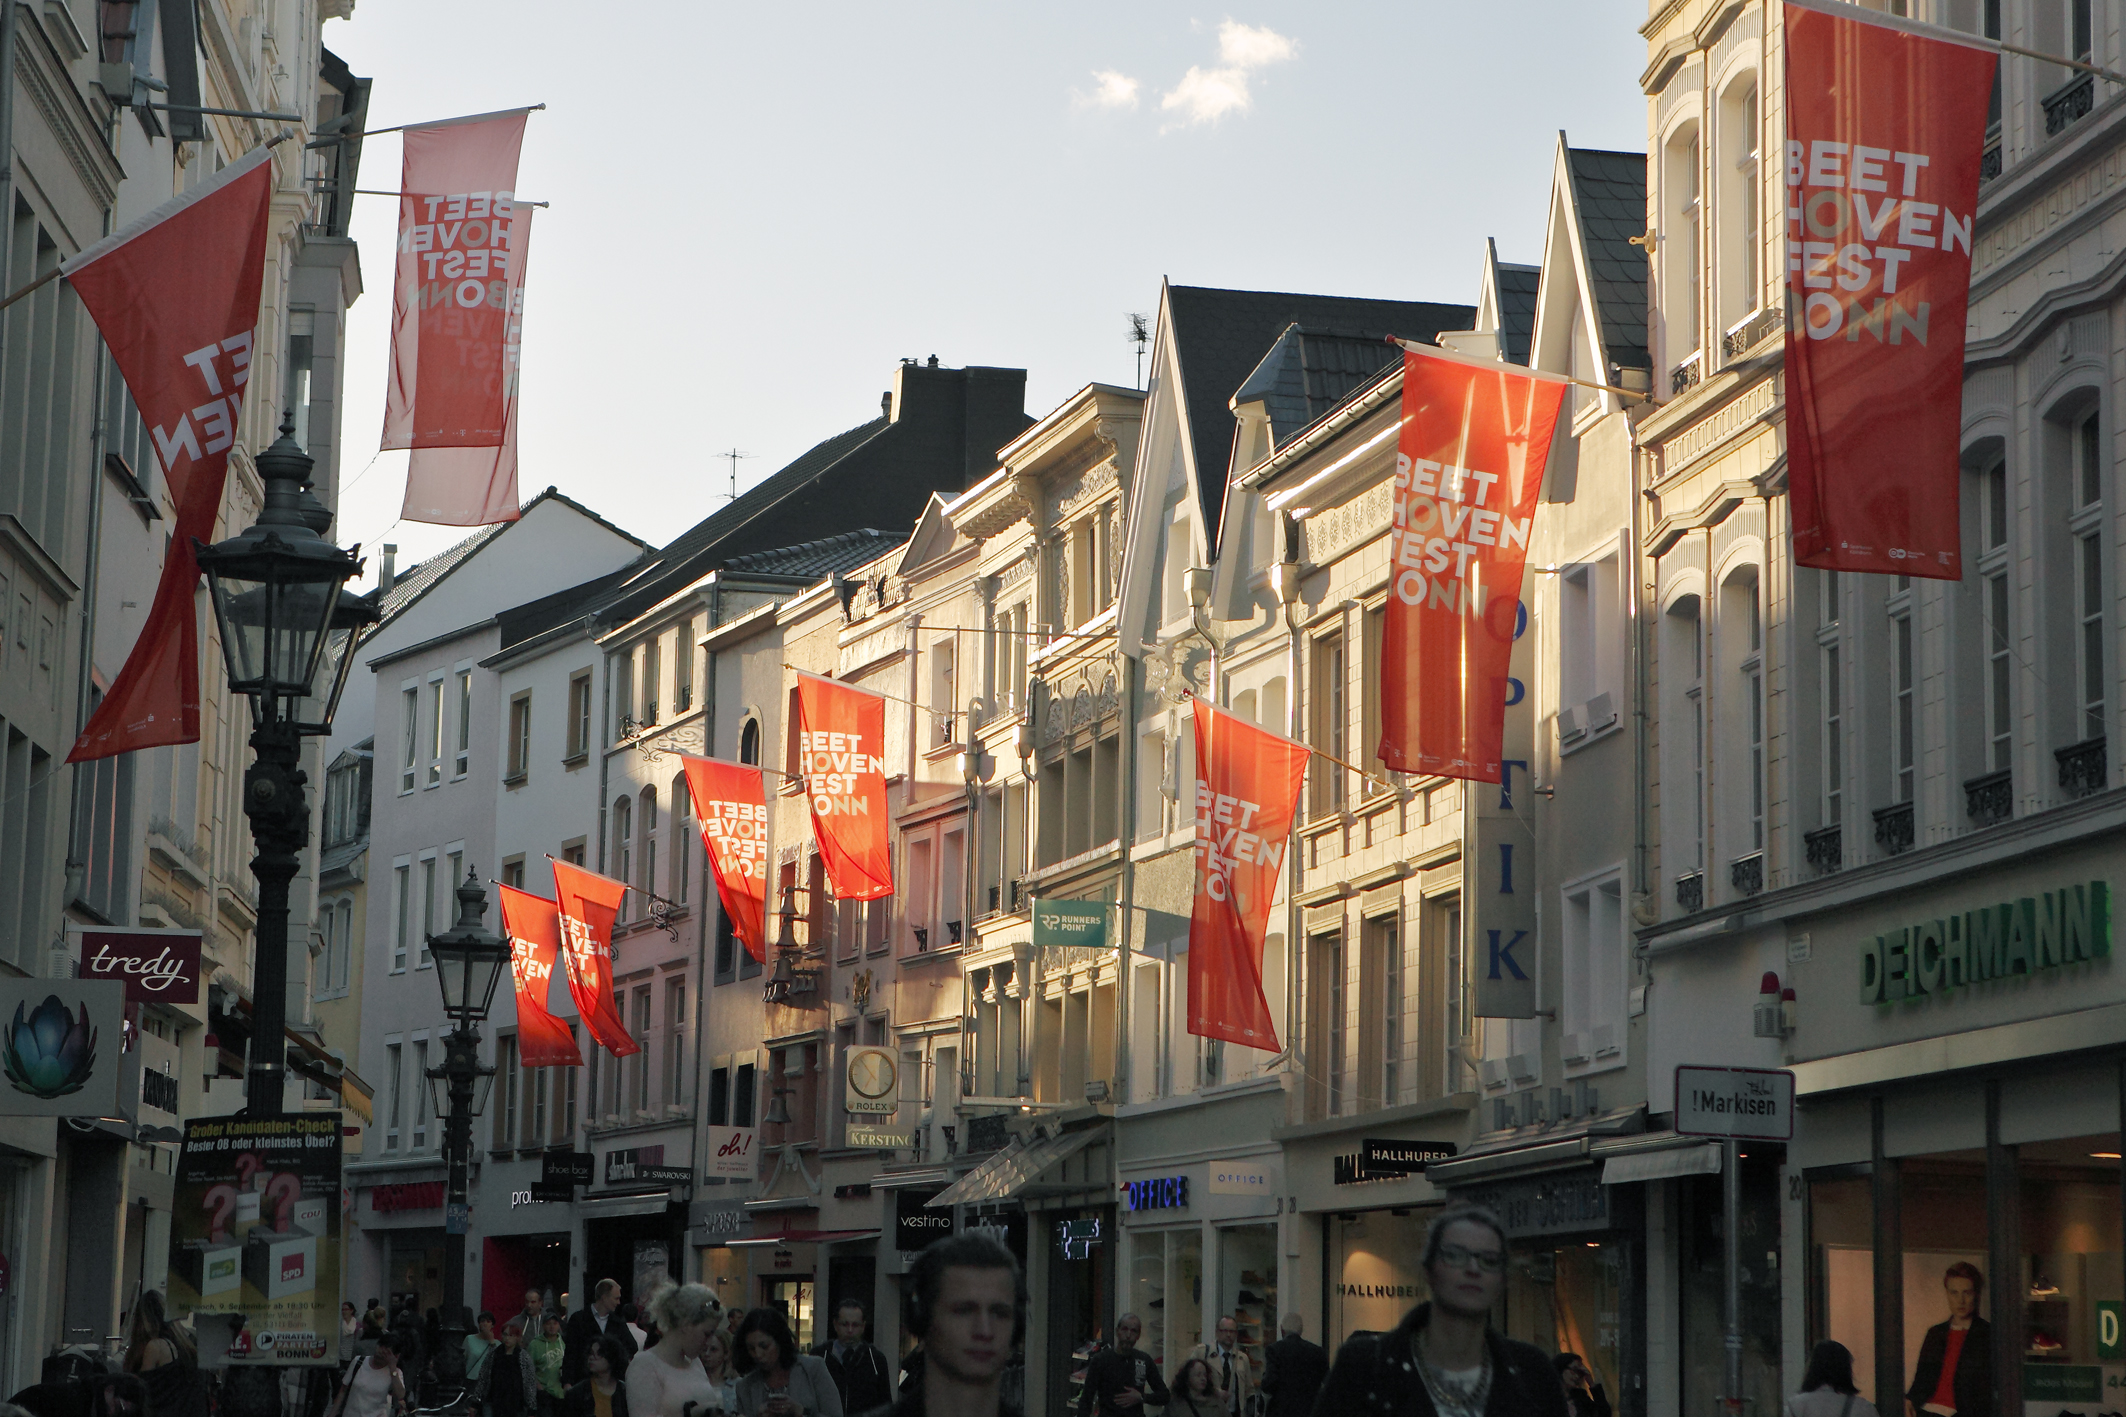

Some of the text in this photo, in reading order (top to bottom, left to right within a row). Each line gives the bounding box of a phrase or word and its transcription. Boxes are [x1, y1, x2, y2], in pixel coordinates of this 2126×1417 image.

[1787, 139, 1930, 197] BEET
[1395, 452, 1499, 506] BEET
[1061, 915, 1101, 925] RUNNERS
[1061, 923, 1086, 932] POINT
[1859, 880, 2109, 1006] DEICHMANN
[90, 944, 190, 991] tredy
[856, 1102, 888, 1110] ROLEX
[189, 1118, 336, 1139] Großer Kandidaten-Check
[187, 1133, 336, 1153] Bester OB oder kleinstes Übel?
[717, 1132, 752, 1157] oh!
[851, 1132, 914, 1147] KERSTING
[548, 1162, 589, 1175] shoe box
[652, 1171, 691, 1180] SWAROVSKI
[1217, 1173, 1264, 1185] OFFICE
[1128, 1175, 1187, 1212] OFFICE
[300, 1210, 322, 1220] CDU
[900, 1214, 951, 1228] vestino
[283, 1267, 301, 1280] SPD
[2101, 1309, 2118, 1347] D
[276, 1350, 309, 1358] BONN
